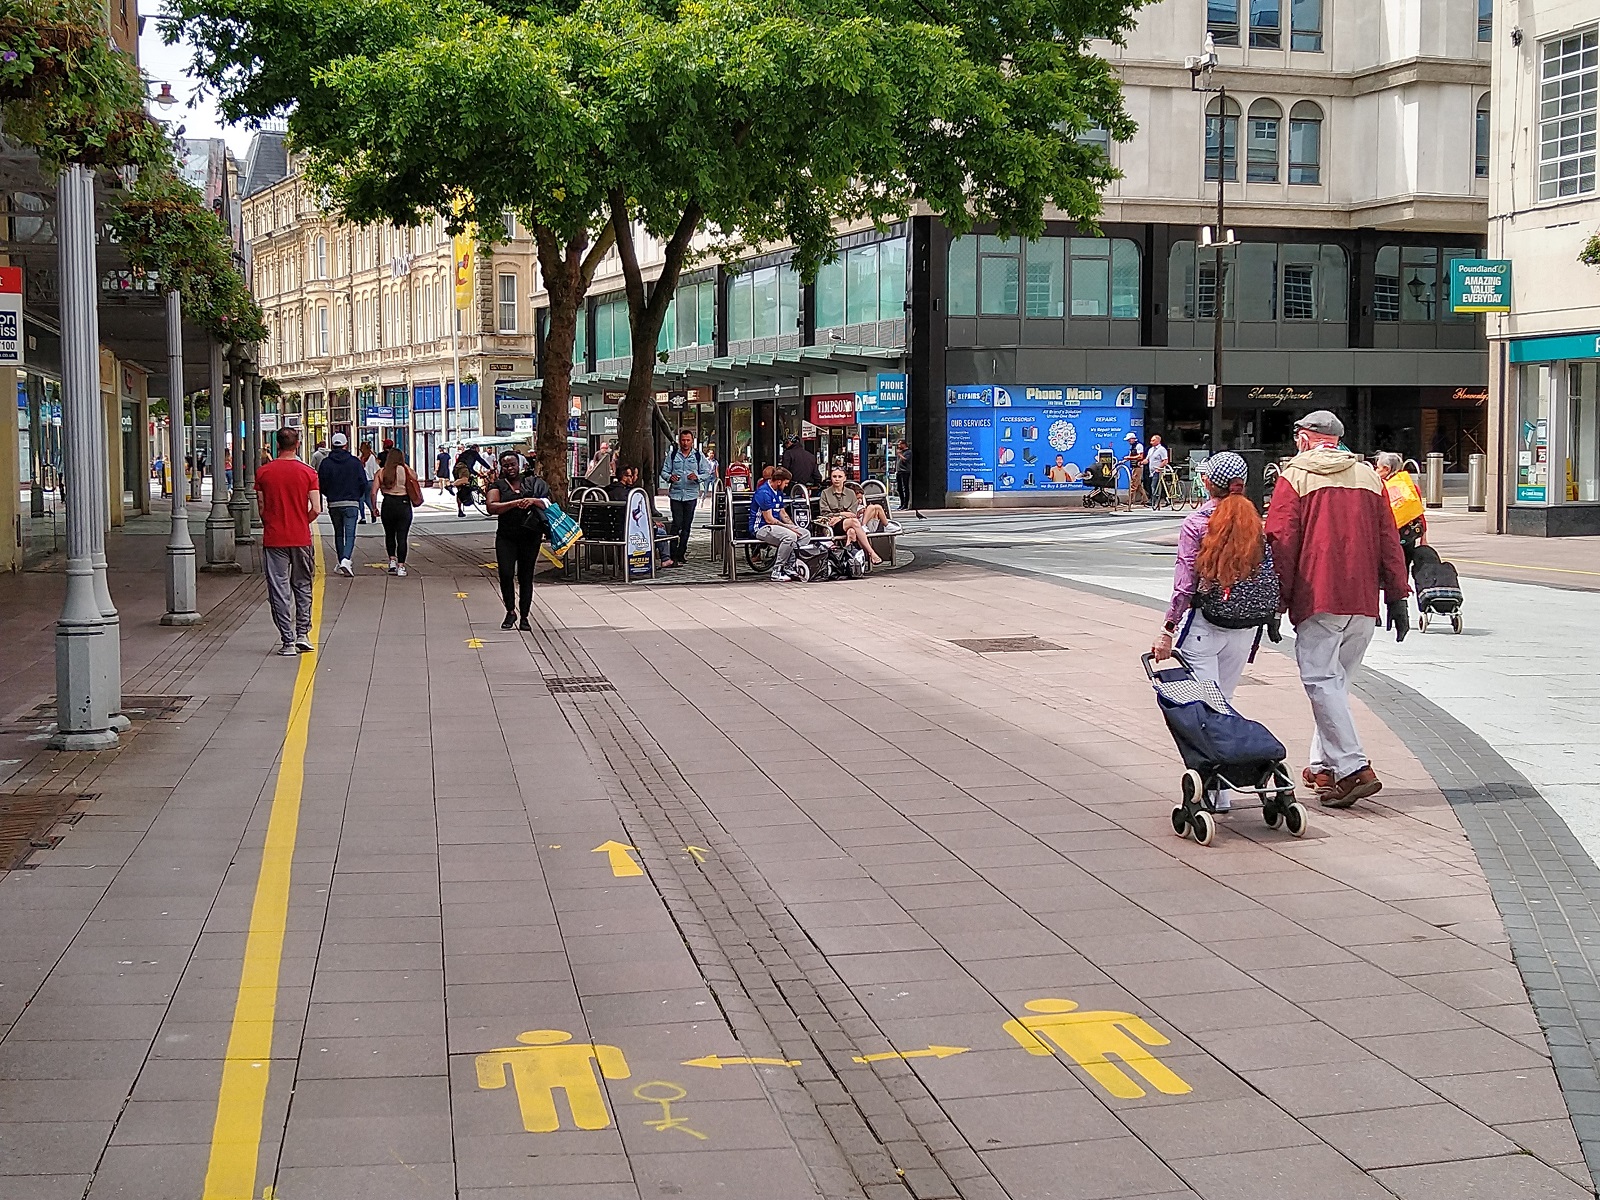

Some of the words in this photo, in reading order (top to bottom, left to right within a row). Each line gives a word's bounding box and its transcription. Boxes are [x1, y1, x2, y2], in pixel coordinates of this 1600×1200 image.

[1458, 264, 1497, 273] Poundland
[1464, 276, 1502, 286] AMAZING
[1470, 285, 1496, 294] VALUE
[1462, 293, 1503, 303] EVERYDAY
[0, 324, 17, 337] iss
[0, 341, 15, 350] 100
[880, 381, 904, 390] PHONE
[880, 392, 904, 401] MANIA
[957, 392, 981, 400] REPAIRS
[1025, 387, 1063, 400] Phone
[1066, 387, 1102, 400] Mania
[817, 399, 853, 413] TIMPSON
[950, 419, 963, 427] OUR
[963, 419, 992, 427] SERVICES
